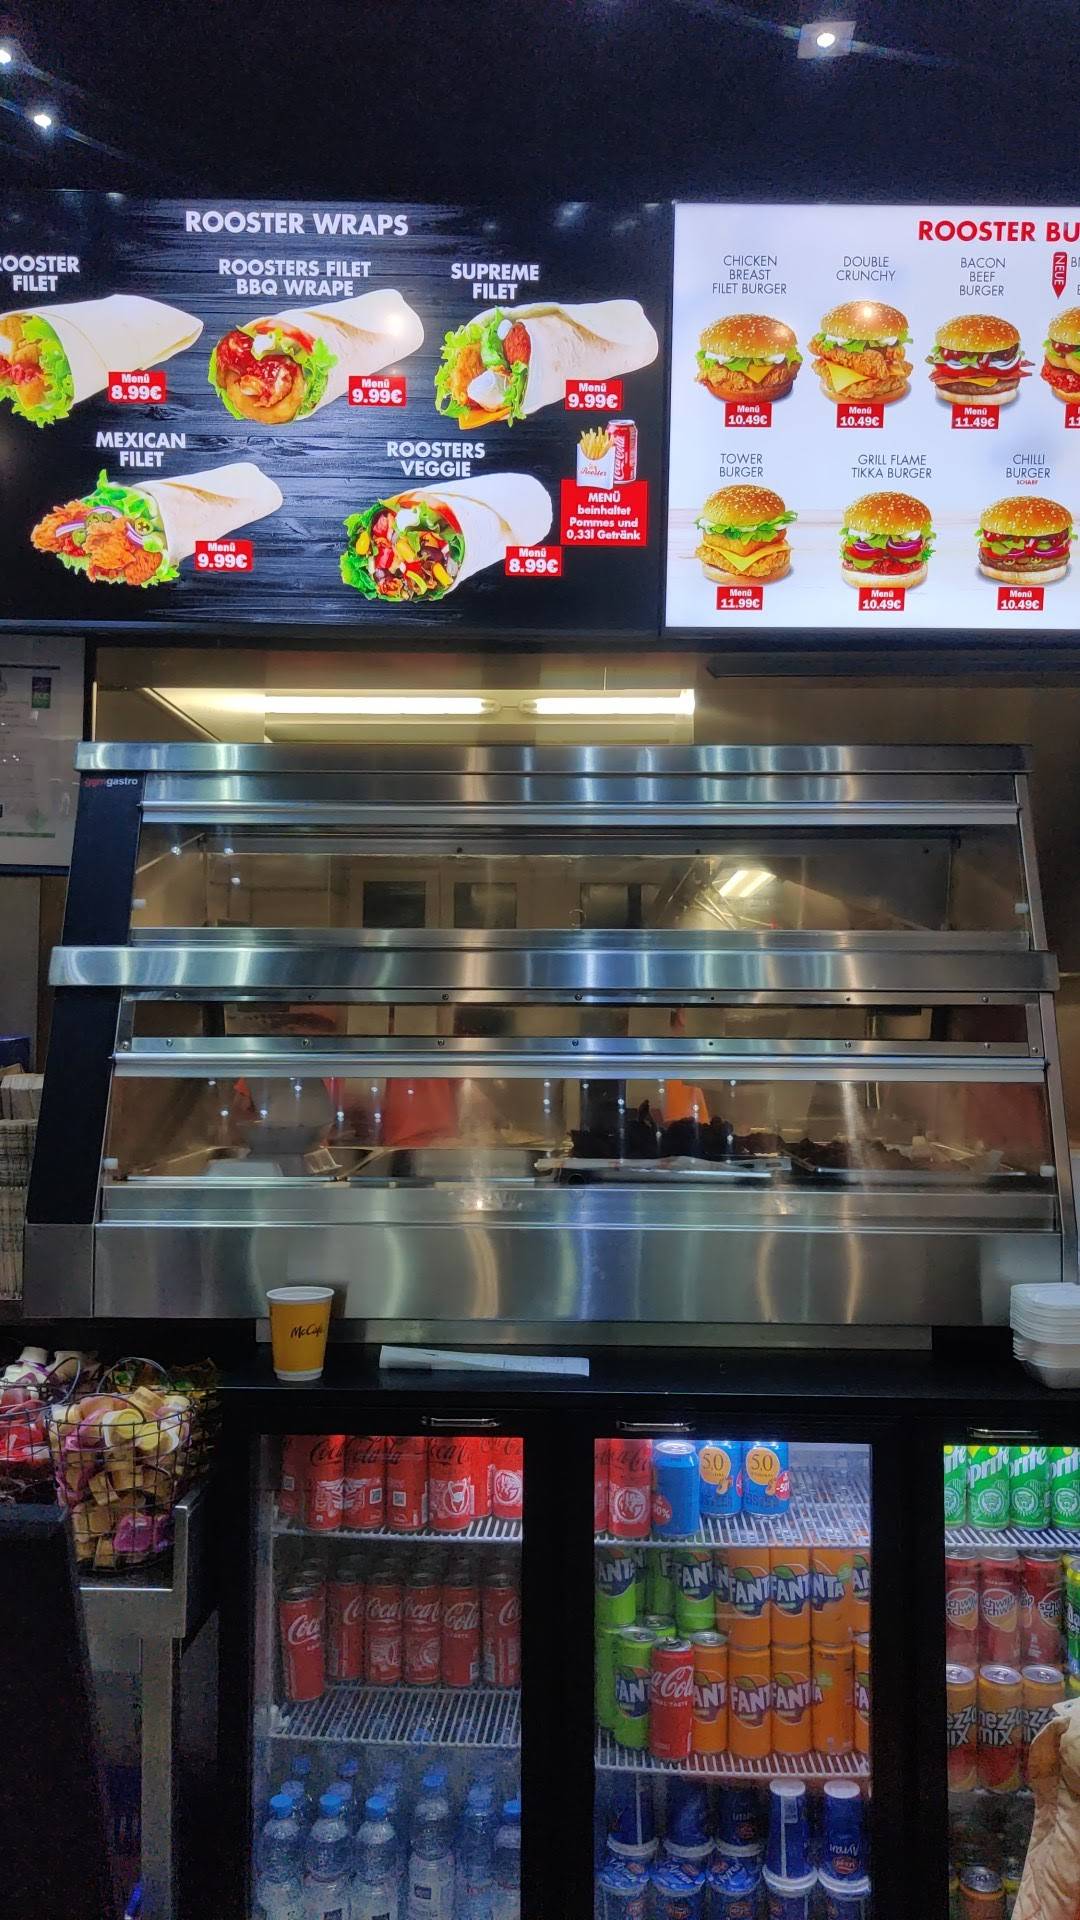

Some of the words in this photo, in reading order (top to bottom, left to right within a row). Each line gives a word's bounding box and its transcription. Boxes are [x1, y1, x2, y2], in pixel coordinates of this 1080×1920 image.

[185, 211, 304, 234] ROOSTER
[312, 214, 409, 236] WRAPS
[919, 220, 1036, 242] ROOSTER
[723, 255, 777, 267] CHICKEN
[843, 256, 889, 267] DOUBLE
[960, 257, 1006, 268] BACON
[219, 259, 319, 277] ROOSTERS
[326, 261, 371, 278] FILET
[451, 263, 539, 281] SUPREME
[1054, 255, 1065, 286] NEUE
[729, 269, 771, 280] BREAST
[836, 270, 896, 282] CRUNCHY
[969, 272, 996, 282] BEEF
[13, 276, 58, 292] FILET
[236, 279, 278, 297] BBQ
[283, 279, 353, 297] WRAPE
[712, 283, 740, 294] FILET
[742, 283, 787, 295] BURGER
[473, 283, 517, 300] FILET
[959, 285, 1004, 297] BURGER
[121, 373, 150, 384] Menü
[361, 378, 390, 388] Menü
[111, 385, 162, 400] 8.99€
[579, 382, 607, 393] Menü
[351, 388, 402, 404] 9.99€
[568, 393, 619, 408] 9.99€
[737, 404, 761, 413] Menü
[849, 405, 872, 414] Menü
[964, 407, 988, 415] Menü
[728, 414, 768, 425] 10.49€
[840, 416, 880, 426] 10.49€
[955, 417, 998, 428] 11.49€
[96, 432, 186, 449] MEXICAN
[387, 441, 486, 458] ROOSTERS
[120, 451, 164, 467] FILET
[720, 454, 763, 465] TOWER
[857, 455, 893, 466] GRILL
[896, 455, 927, 466] FLAME
[1013, 454, 1046, 465] CHILLI
[400, 461, 470, 477] VEGGIE
[719, 467, 764, 478] BURGER
[852, 468, 884, 479] TIKKA
[887, 468, 932, 479] BURGER
[1006, 467, 1051, 478] BURGER
[588, 491, 621, 502] MENÜ
[577, 504, 631, 515] beinhaltet
[569, 517, 614, 527] Pommes
[618, 518, 639, 528] und
[597, 530, 640, 540] Getränk
[208, 542, 236, 552] Menü
[519, 548, 547, 558] Menü
[198, 553, 248, 568] 9.99€
[509, 559, 559, 574] 8.99€
[729, 589, 753, 598] Menü
[871, 590, 894, 599] Menü
[1009, 590, 1033, 598] Menü
[721, 599, 761, 610] 11.99€
[862, 600, 902, 610] 10.49€
[1000, 600, 1041, 610] 10.49€
